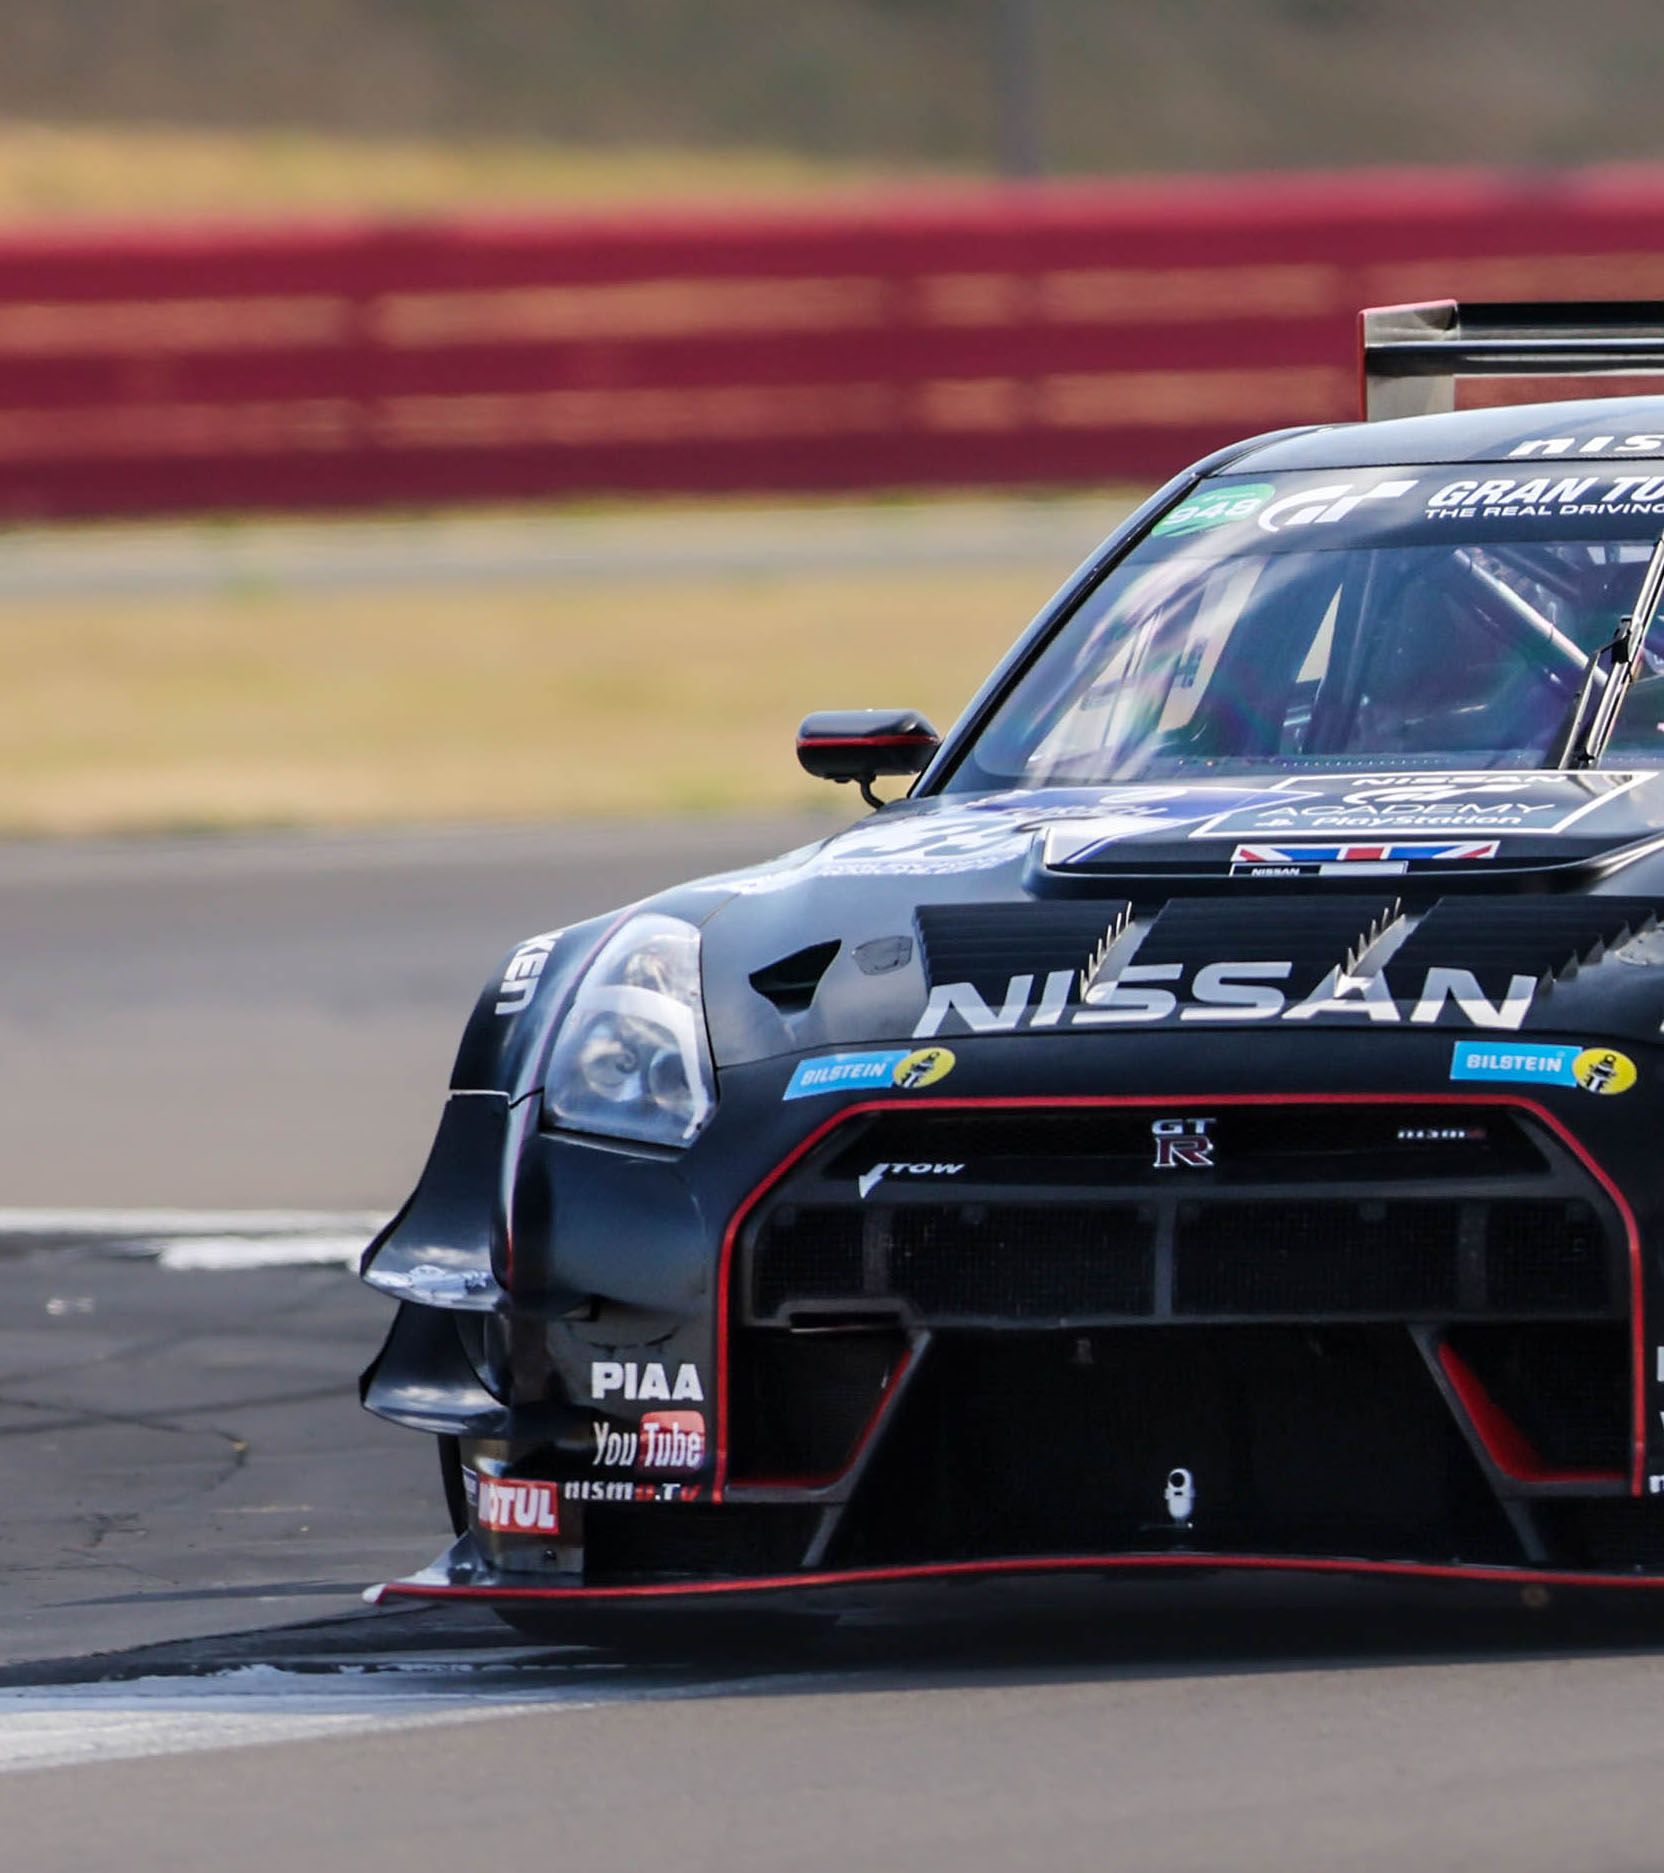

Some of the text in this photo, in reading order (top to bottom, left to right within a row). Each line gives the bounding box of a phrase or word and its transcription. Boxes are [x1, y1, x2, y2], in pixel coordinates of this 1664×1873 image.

[1428, 477, 1600, 506] GRAN
[1425, 507, 1480, 519] THE
[1483, 505, 1552, 517] REAL
[1352, 775, 1568, 786] NISSAN
[1257, 803, 1556, 817] ACADEMY
[1312, 814, 1522, 827] PlayStation
[1250, 868, 1300, 876] NISSAN
[913, 961, 1537, 1038] NISSAN
[1466, 1053, 1563, 1073] BILSTEIN
[800, 1062, 888, 1087] BILSTEIN
[891, 1163, 966, 1174] TOW
[592, 1361, 704, 1401] PIAA
